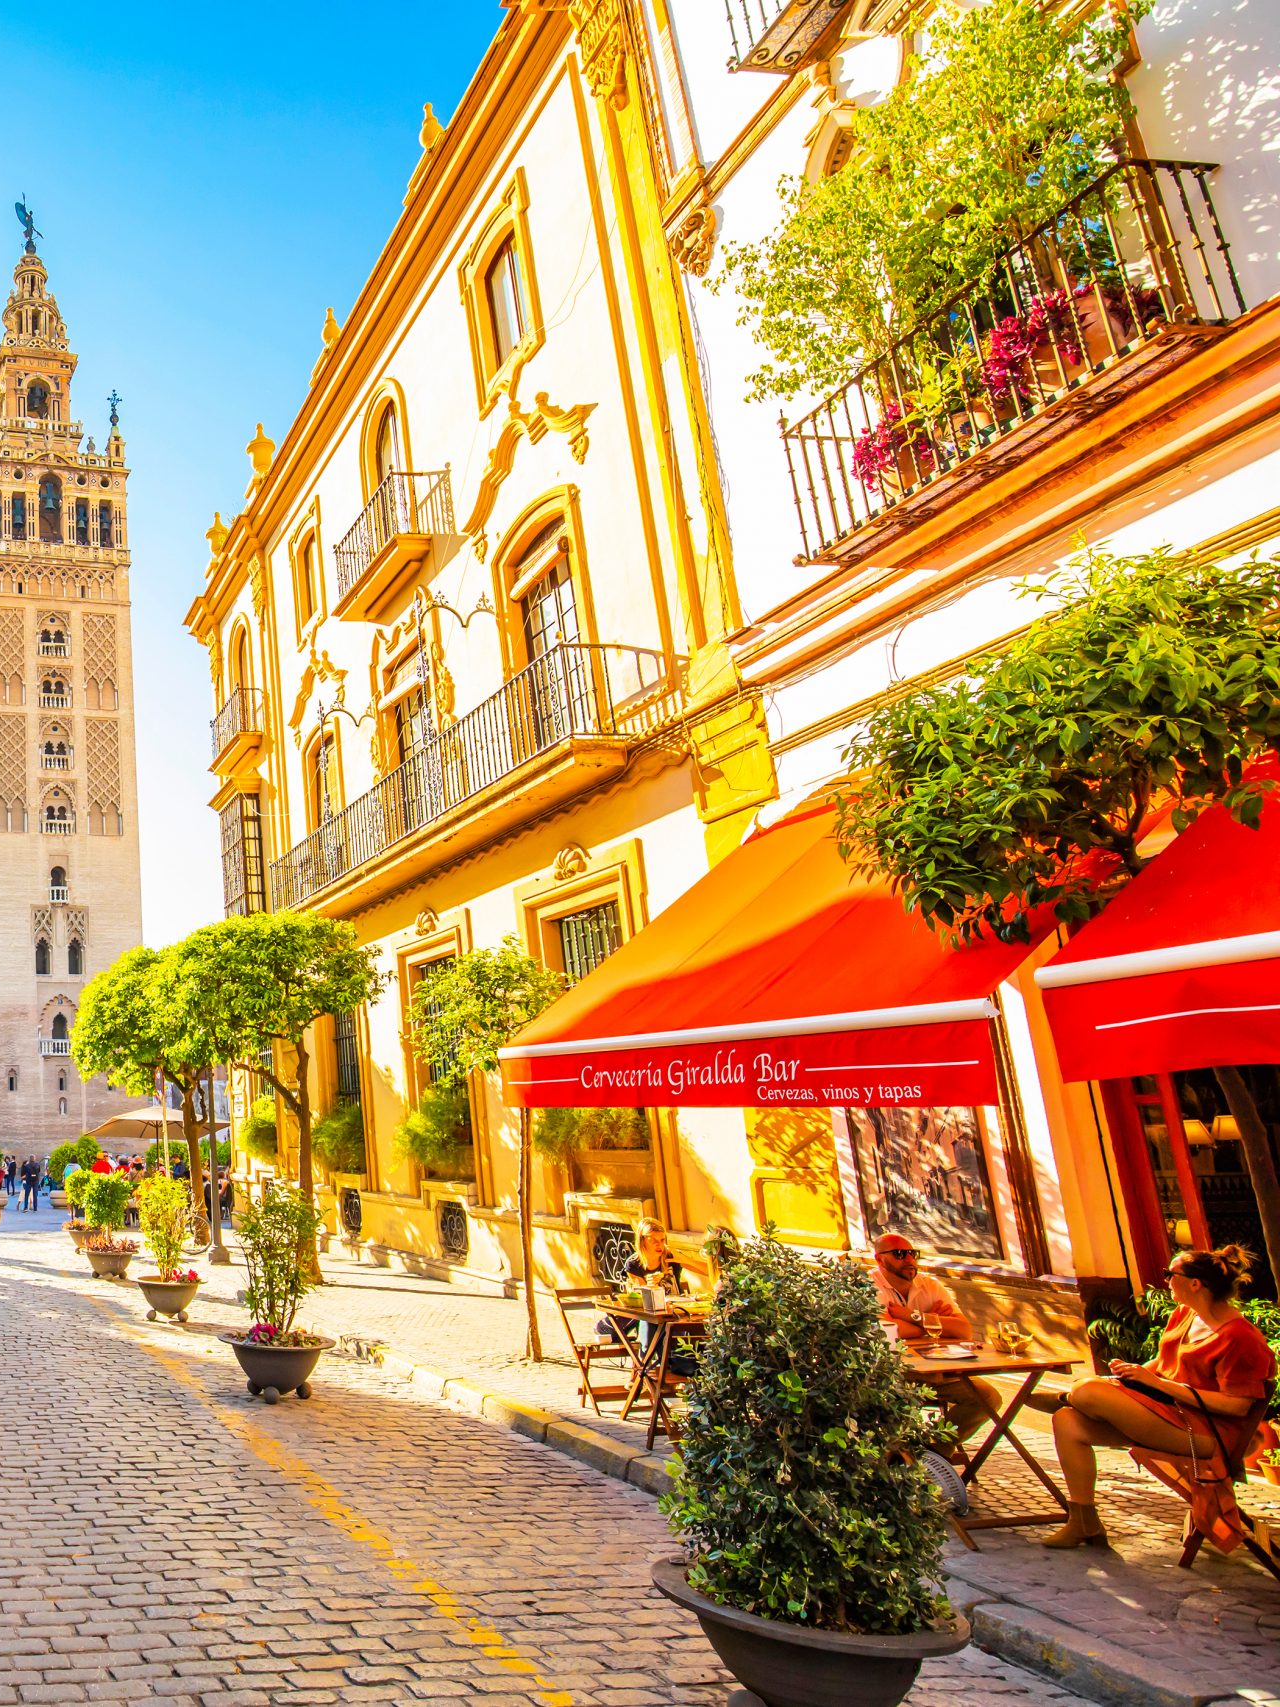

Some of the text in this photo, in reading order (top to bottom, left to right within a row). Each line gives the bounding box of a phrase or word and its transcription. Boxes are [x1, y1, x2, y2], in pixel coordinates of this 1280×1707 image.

[580, 1049, 800, 1095] Cervecería Giralda Bar
[757, 1083, 922, 1103] Cervezas, vinos y tapas
